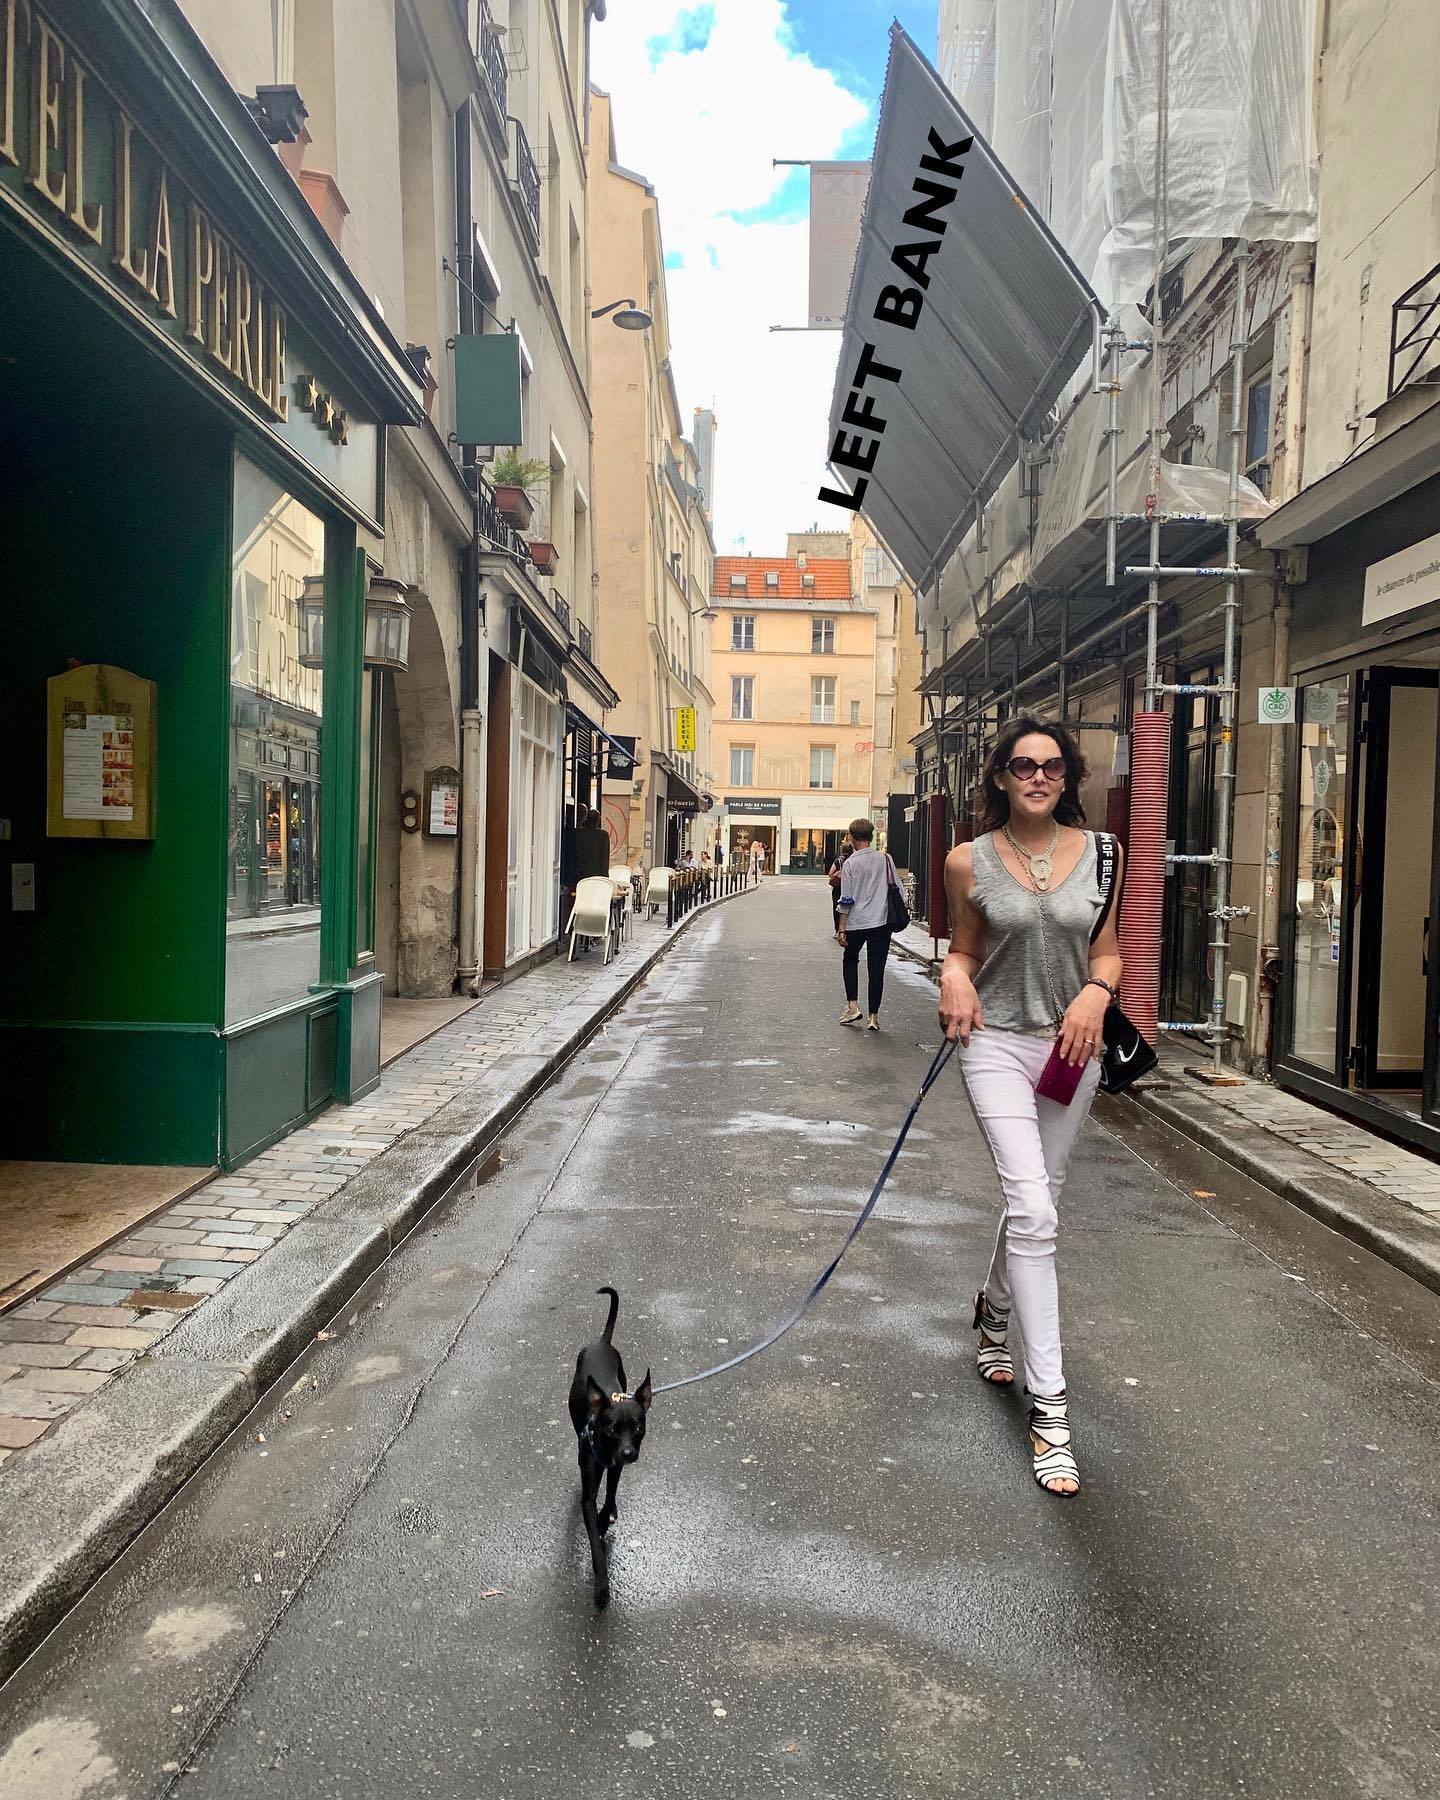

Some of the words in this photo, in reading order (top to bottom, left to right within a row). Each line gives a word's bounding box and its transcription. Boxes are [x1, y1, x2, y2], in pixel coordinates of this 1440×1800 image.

[112, 110, 177, 320] LA
[186, 202, 289, 423] PERLE
[1268, 702, 1285, 710] CBD
[1102, 844, 1114, 857] OF
[1168, 1022, 1193, 1031] AFIX
